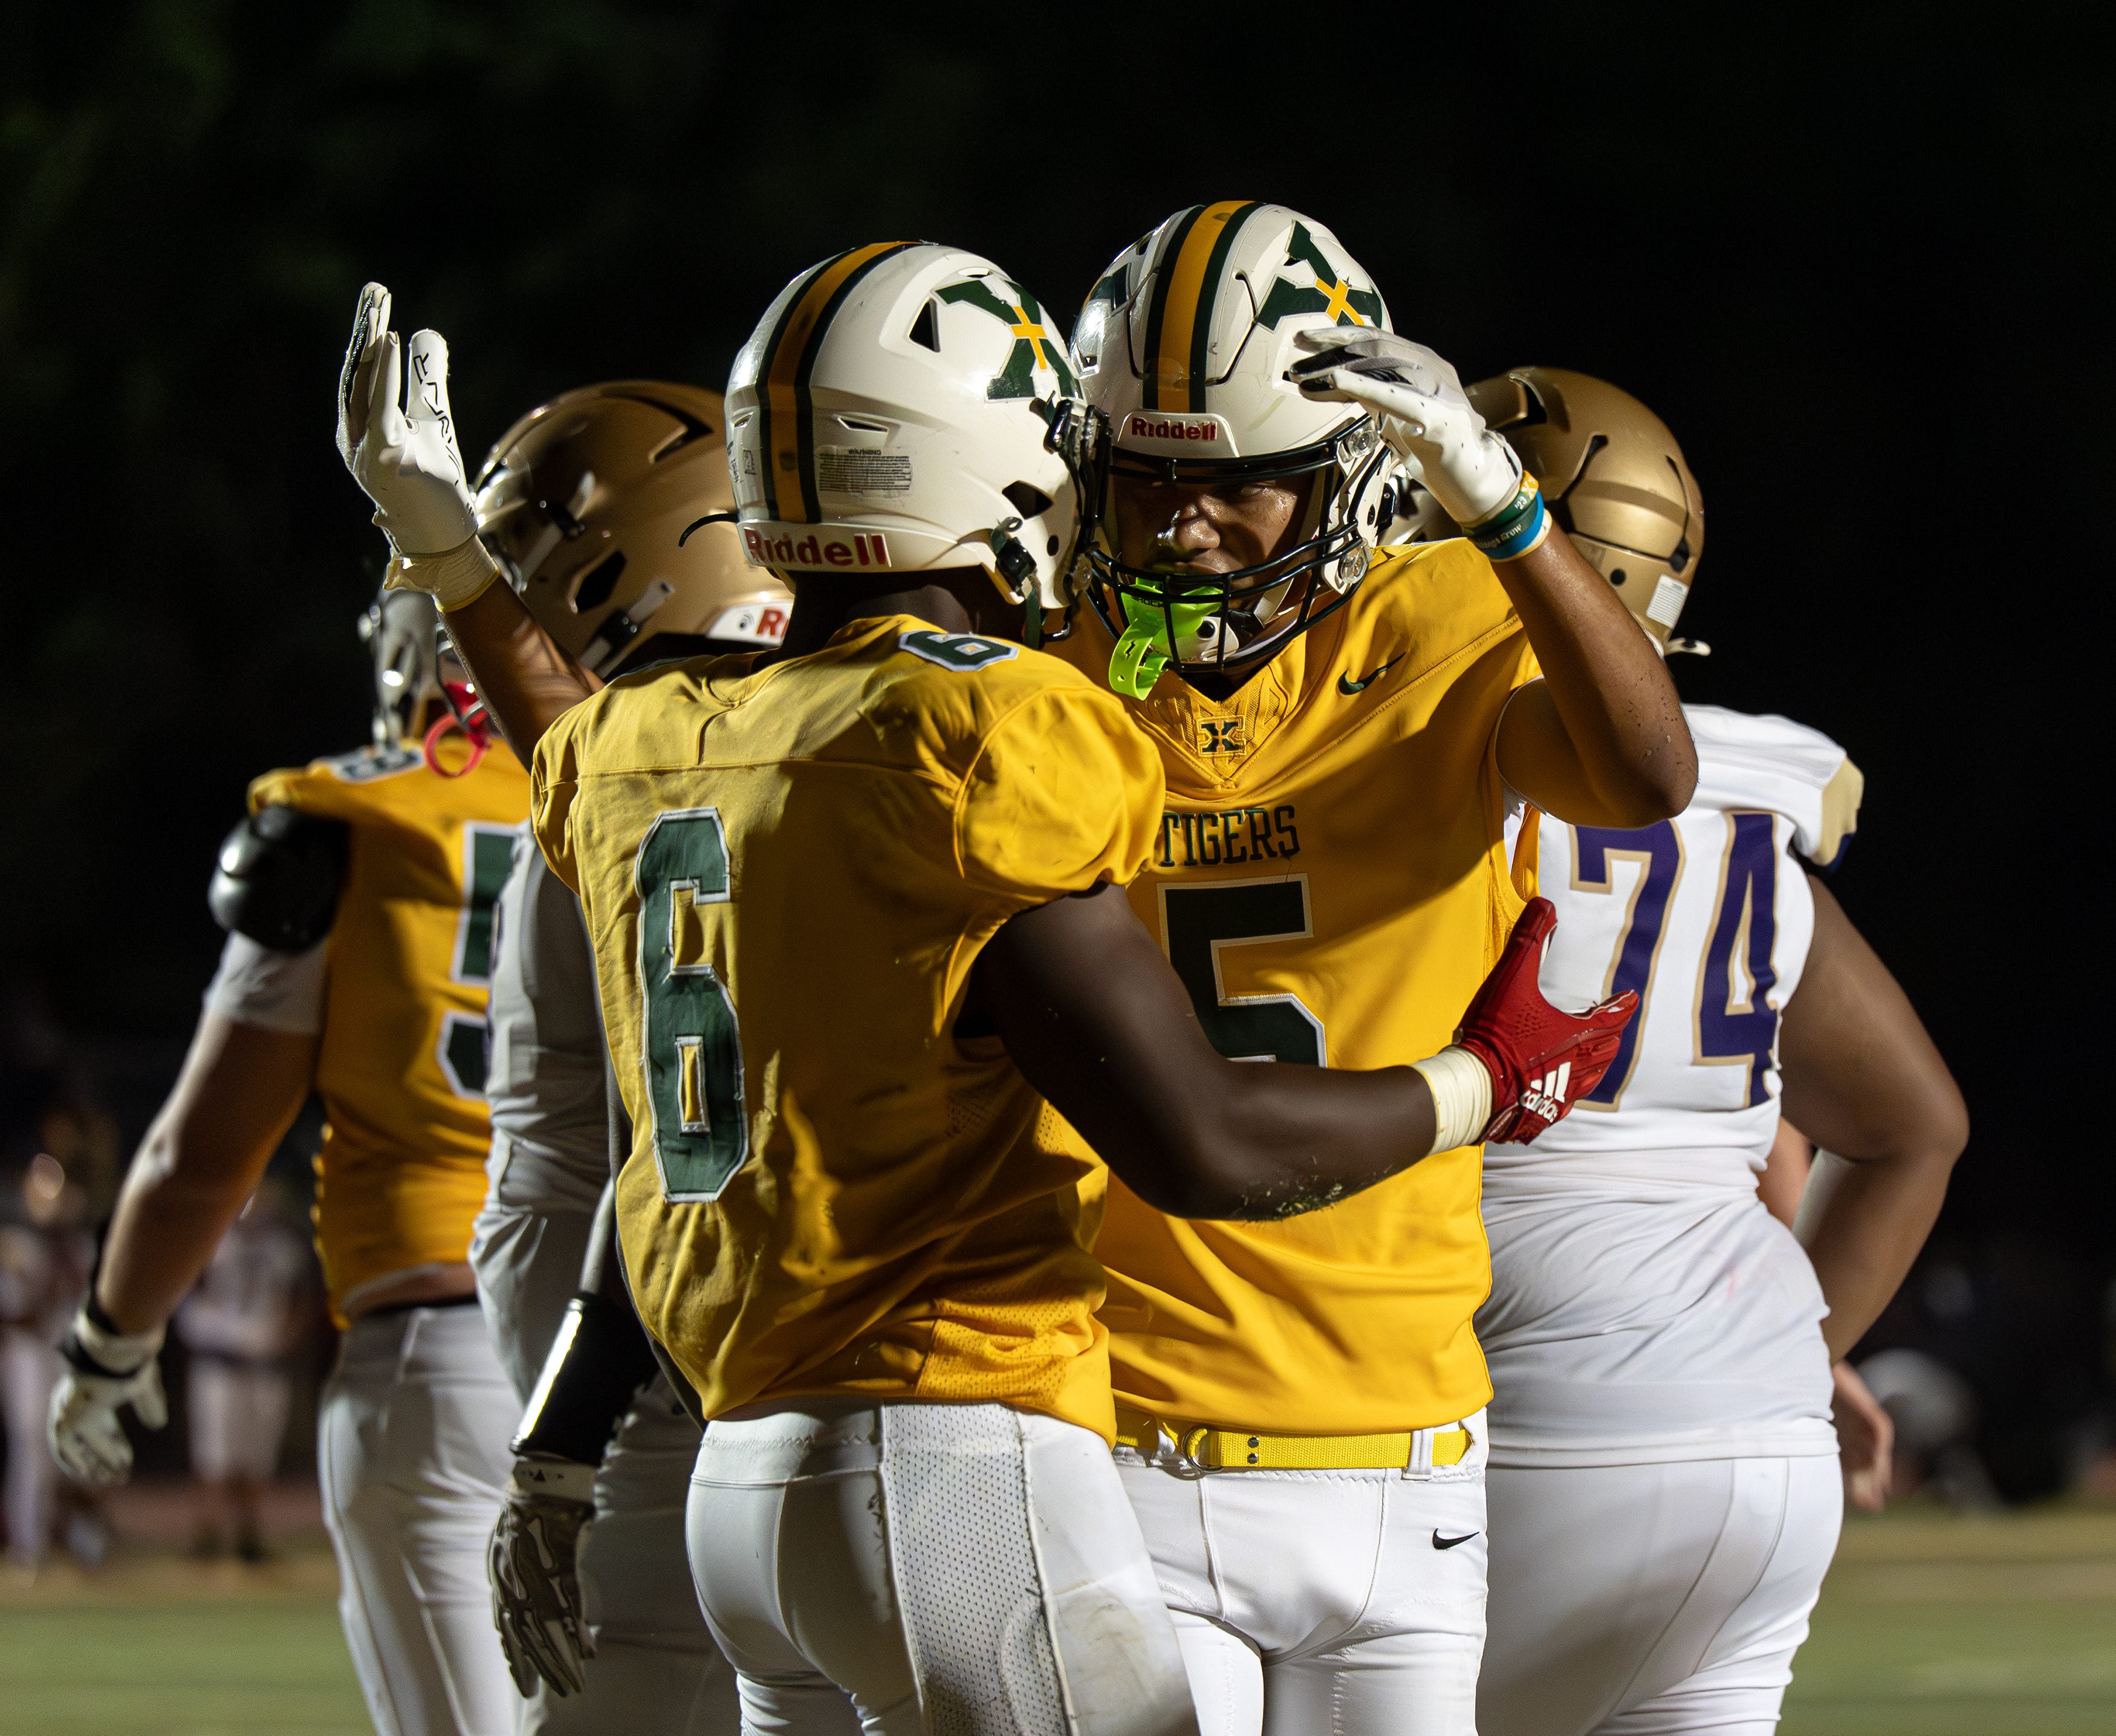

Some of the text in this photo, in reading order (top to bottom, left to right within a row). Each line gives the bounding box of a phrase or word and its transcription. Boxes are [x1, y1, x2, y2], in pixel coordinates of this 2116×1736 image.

[1131, 416, 1218, 441] Riddell
[744, 527, 892, 567] Riddell
[898, 629, 1020, 672] 6
[1158, 805, 1300, 867] TIGERS
[1156, 873, 1327, 1068] 5
[1569, 811, 1782, 1113] 74
[635, 807, 748, 1203] 6
